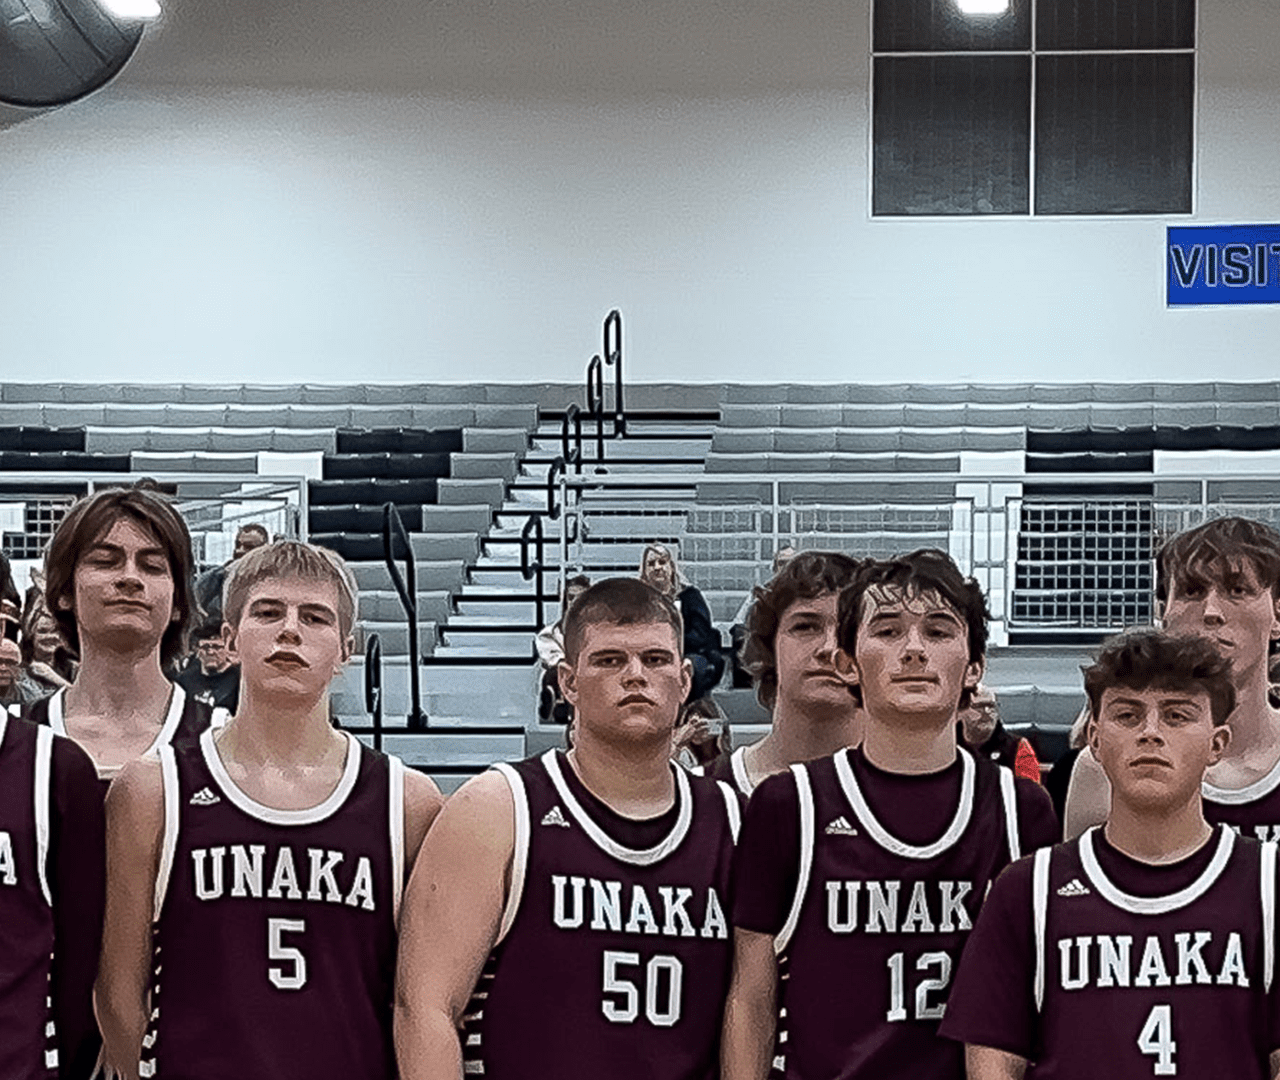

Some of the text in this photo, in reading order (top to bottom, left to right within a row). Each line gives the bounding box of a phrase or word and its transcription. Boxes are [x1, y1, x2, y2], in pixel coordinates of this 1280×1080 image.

[192, 845, 375, 911] UNAKA
[552, 875, 727, 939] UNAKA
[825, 878, 992, 933] UNAK
[269, 918, 307, 990] 5
[602, 950, 683, 1026] 50
[886, 951, 952, 1022] 12
[1058, 931, 1249, 989] UNAKA
[1137, 1004, 1177, 1076] 4
